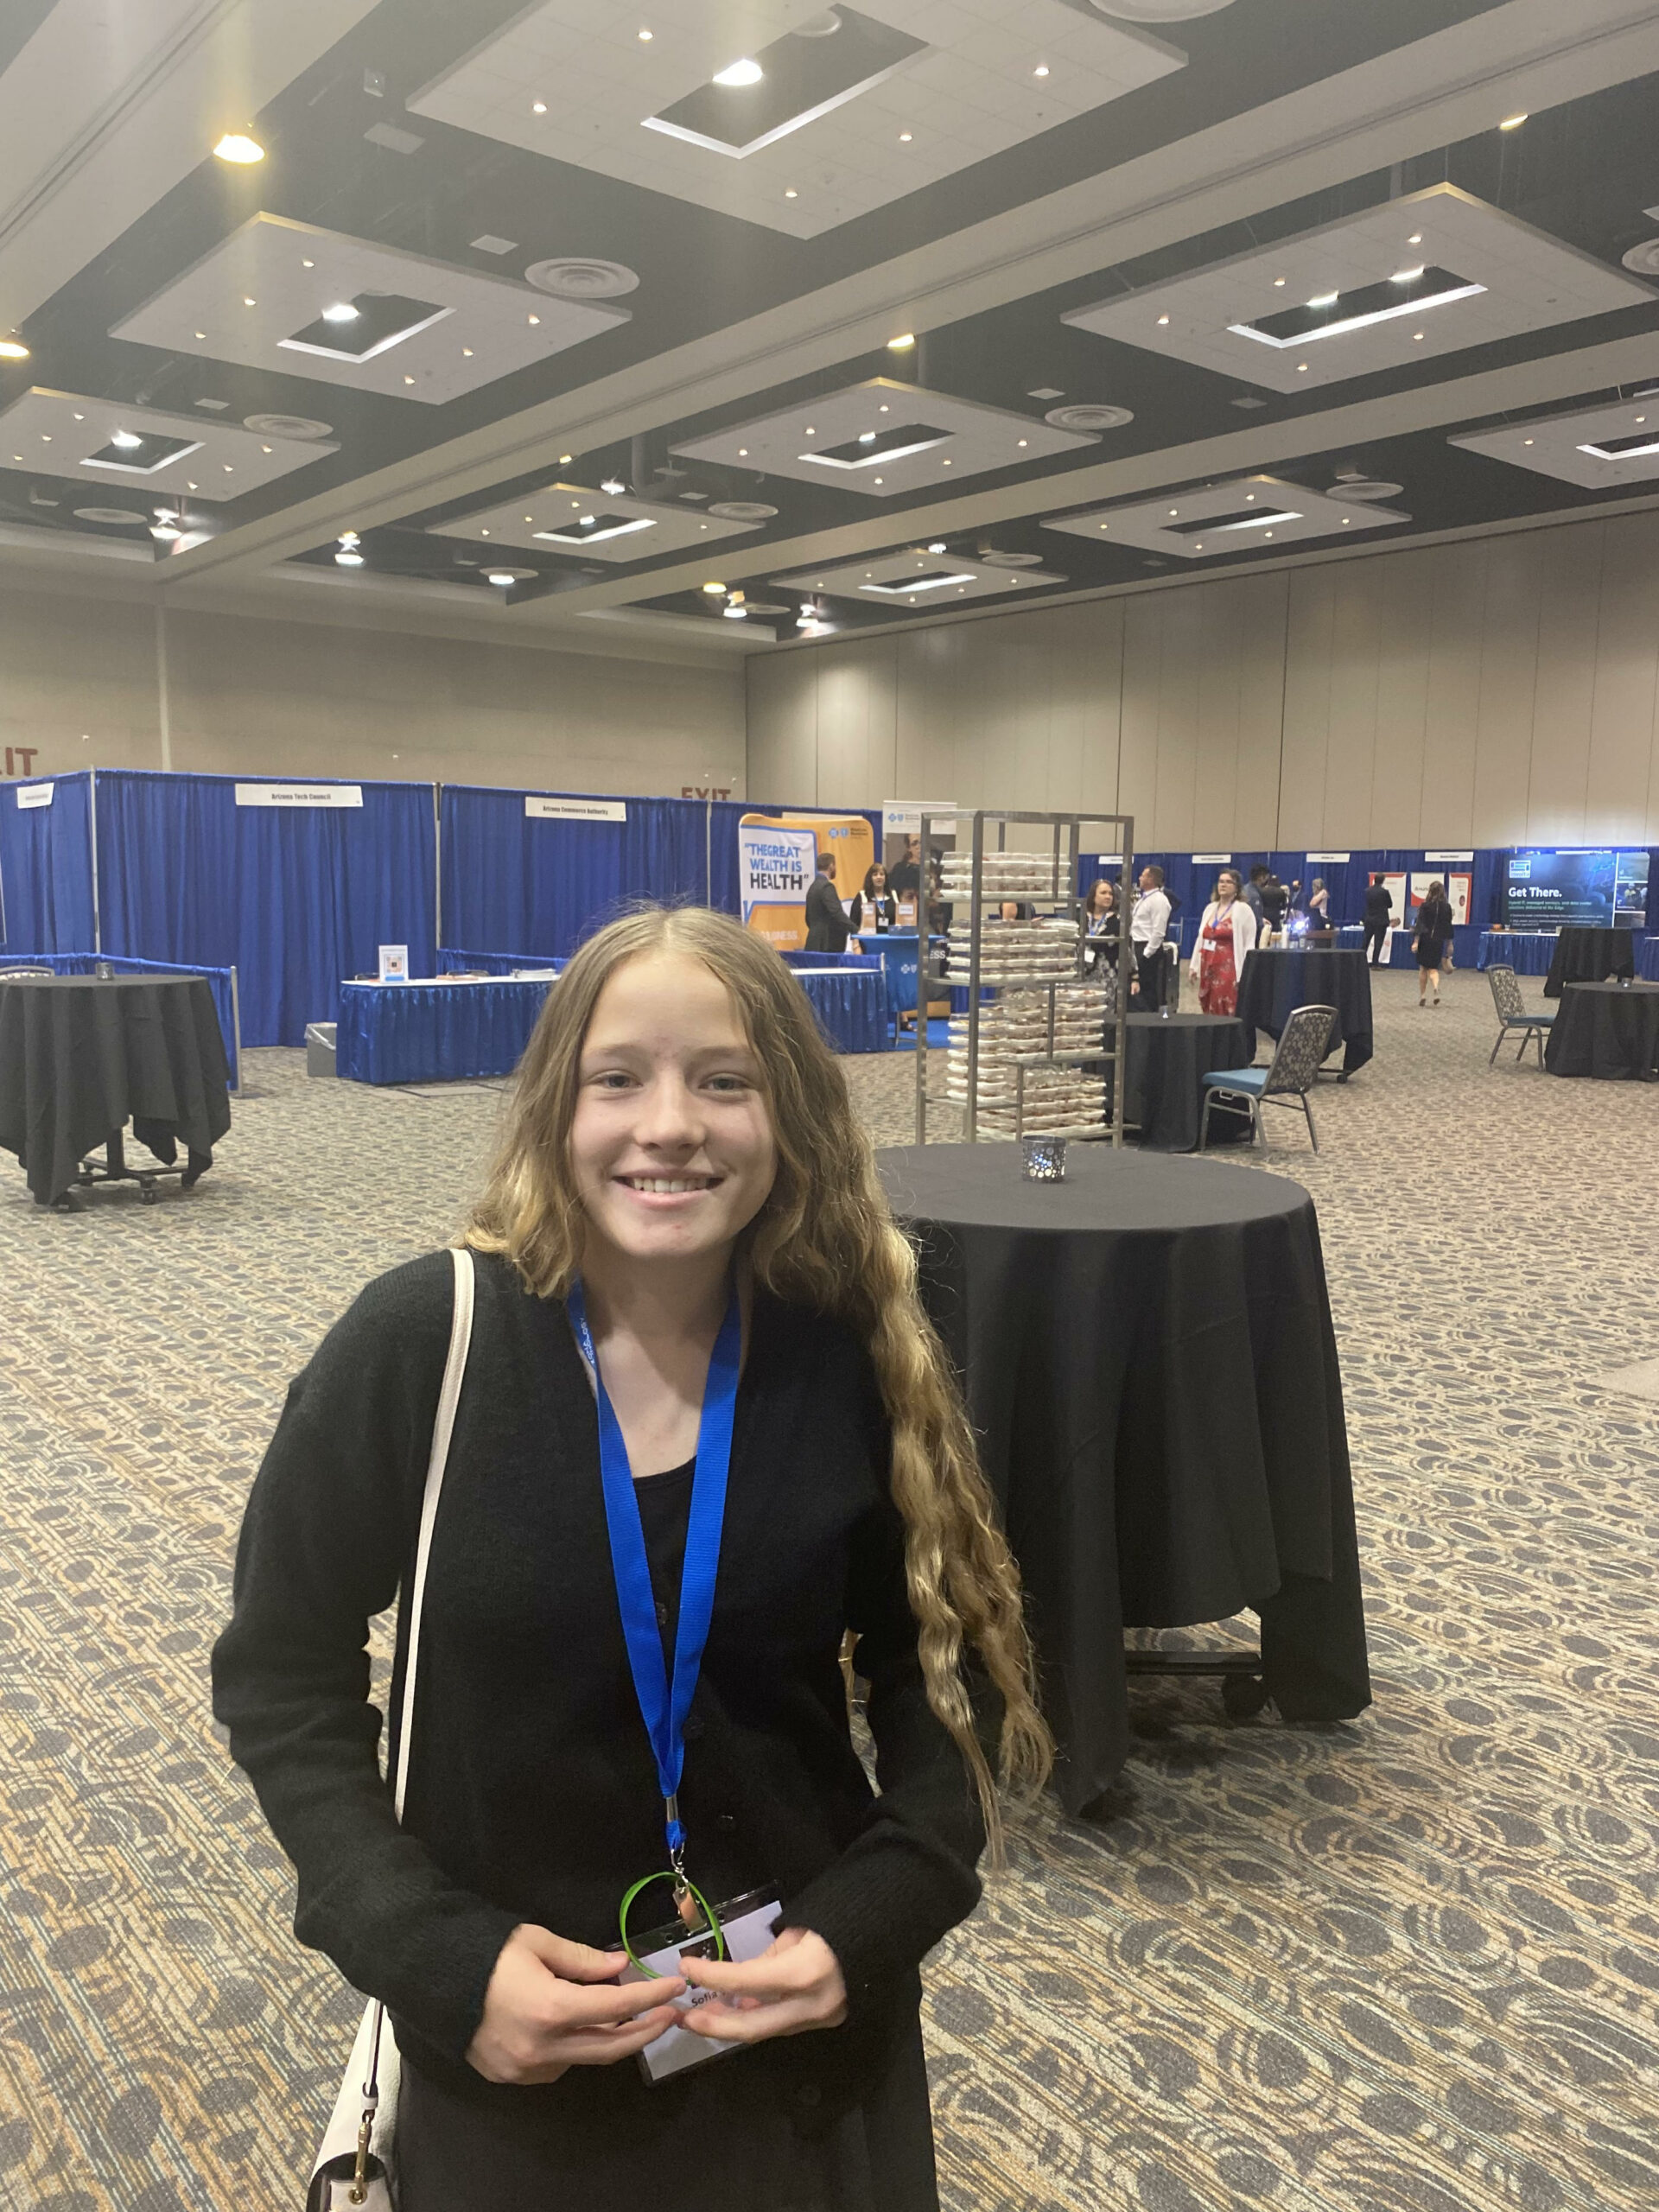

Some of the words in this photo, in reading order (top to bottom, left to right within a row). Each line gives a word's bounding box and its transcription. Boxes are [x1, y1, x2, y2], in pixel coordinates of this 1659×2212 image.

[0, 747, 38, 776] IT
[750, 858, 788, 872] WEALTH
[791, 861, 802, 872] IS
[1508, 887, 1527, 898] Get
[1529, 887, 1562, 898] There.
[691, 1991, 718, 2008] Sofia
